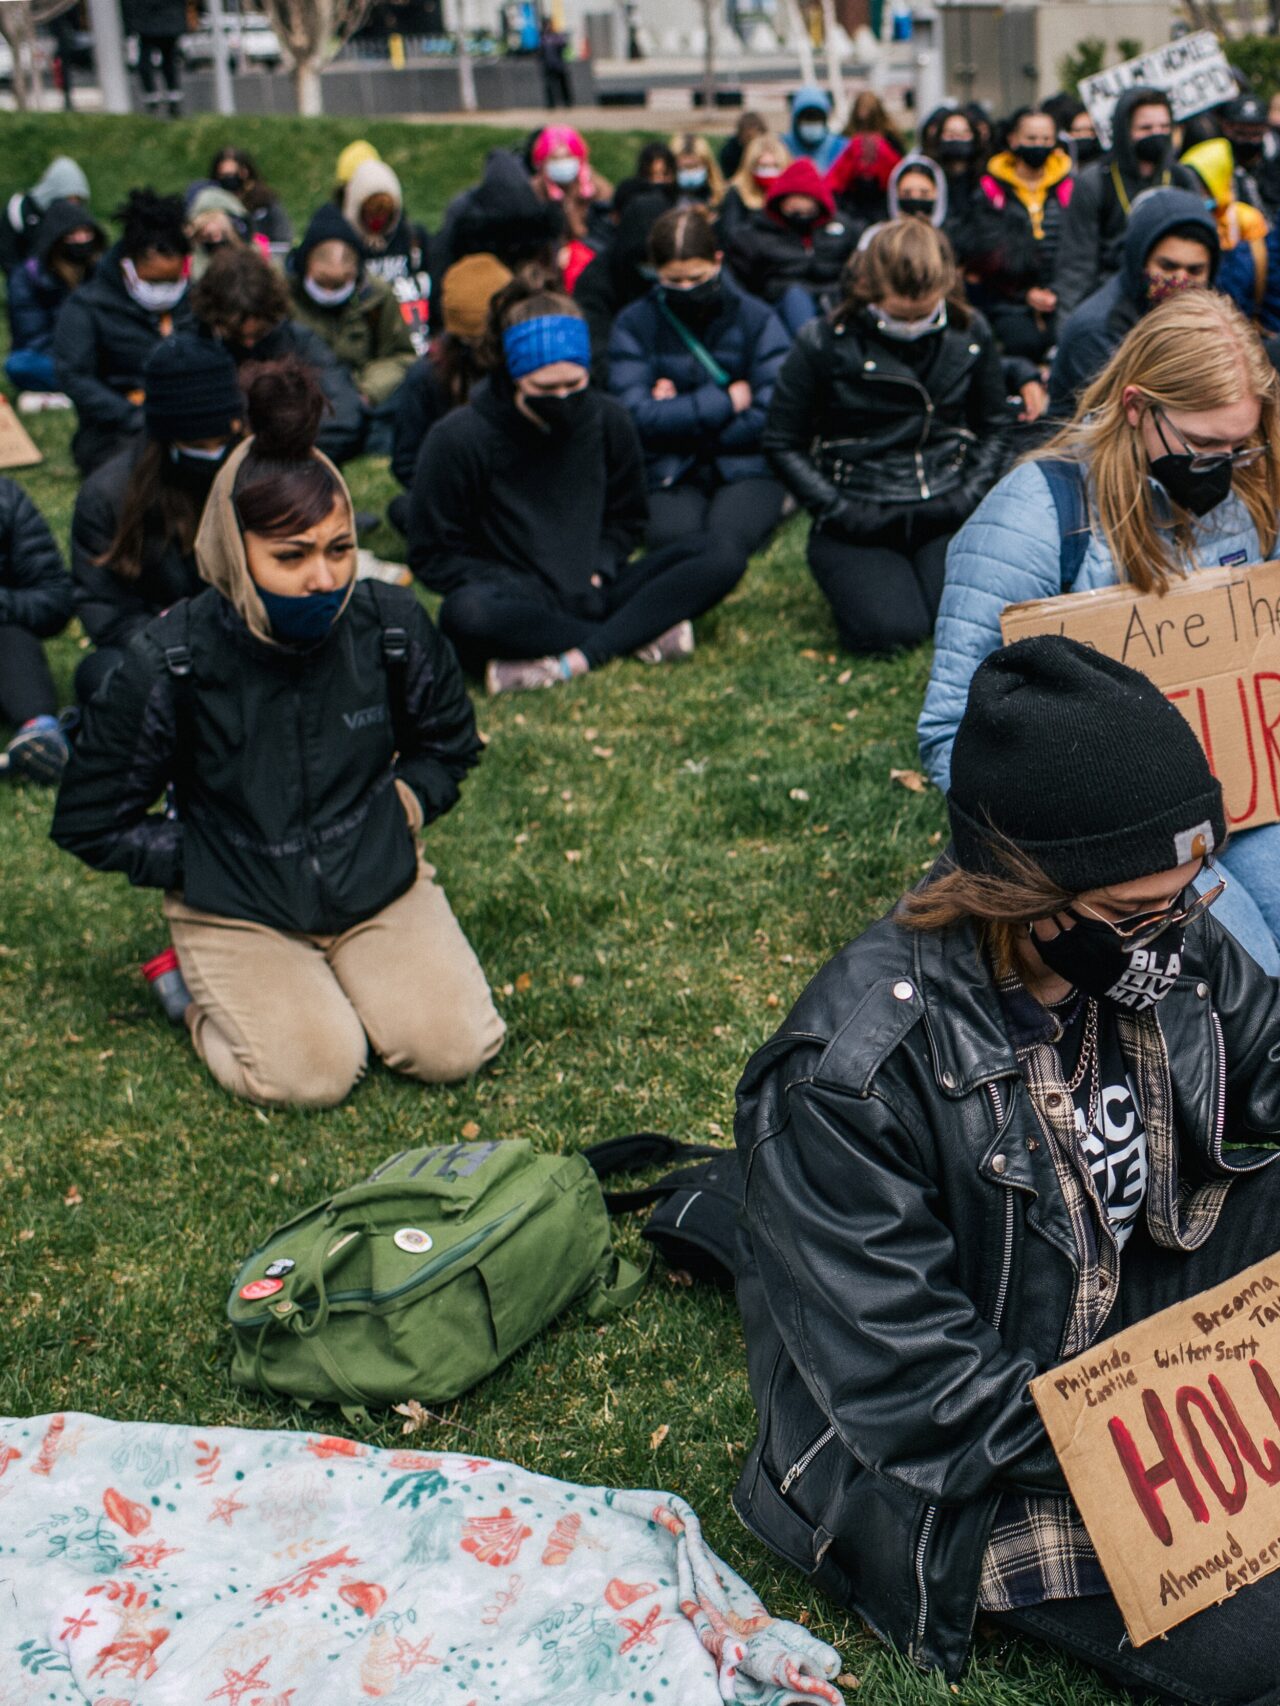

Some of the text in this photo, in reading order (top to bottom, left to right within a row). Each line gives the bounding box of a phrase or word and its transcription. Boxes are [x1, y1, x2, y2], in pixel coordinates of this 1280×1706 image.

[1121, 604, 1210, 663] Are
[1129, 949, 1182, 978] BLA
[1191, 1275, 1279, 1336] Breonna
[1054, 1348, 1131, 1401] Philando
[1153, 1334, 1260, 1369] Walter Scott
[1084, 1368, 1139, 1408] Castile
[1159, 1530, 1244, 1606] Ahmaud
